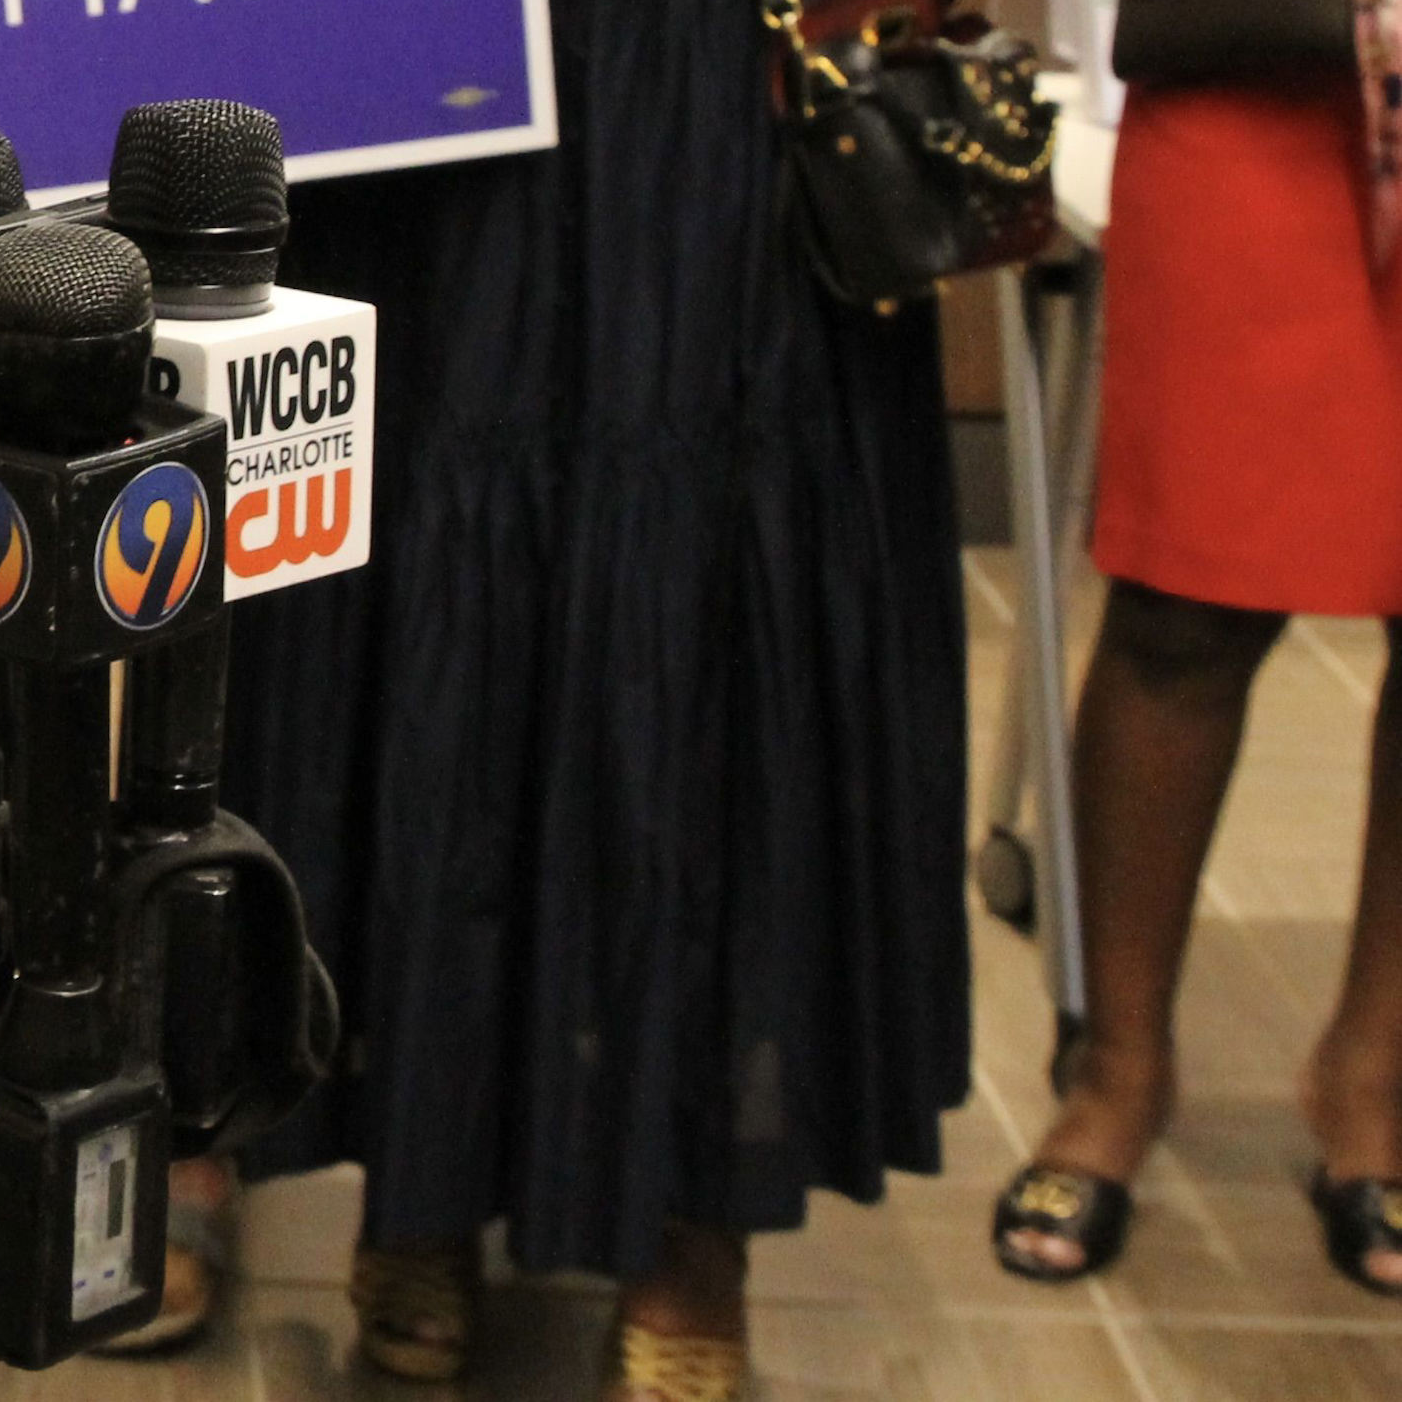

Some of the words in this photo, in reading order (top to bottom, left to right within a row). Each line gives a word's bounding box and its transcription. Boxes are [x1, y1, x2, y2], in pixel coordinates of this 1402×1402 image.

[226, 335, 356, 441] WCCB
[226, 431, 354, 486] CHARLOTTE
[116, 463, 199, 626] 9
[225, 467, 353, 579] CW
